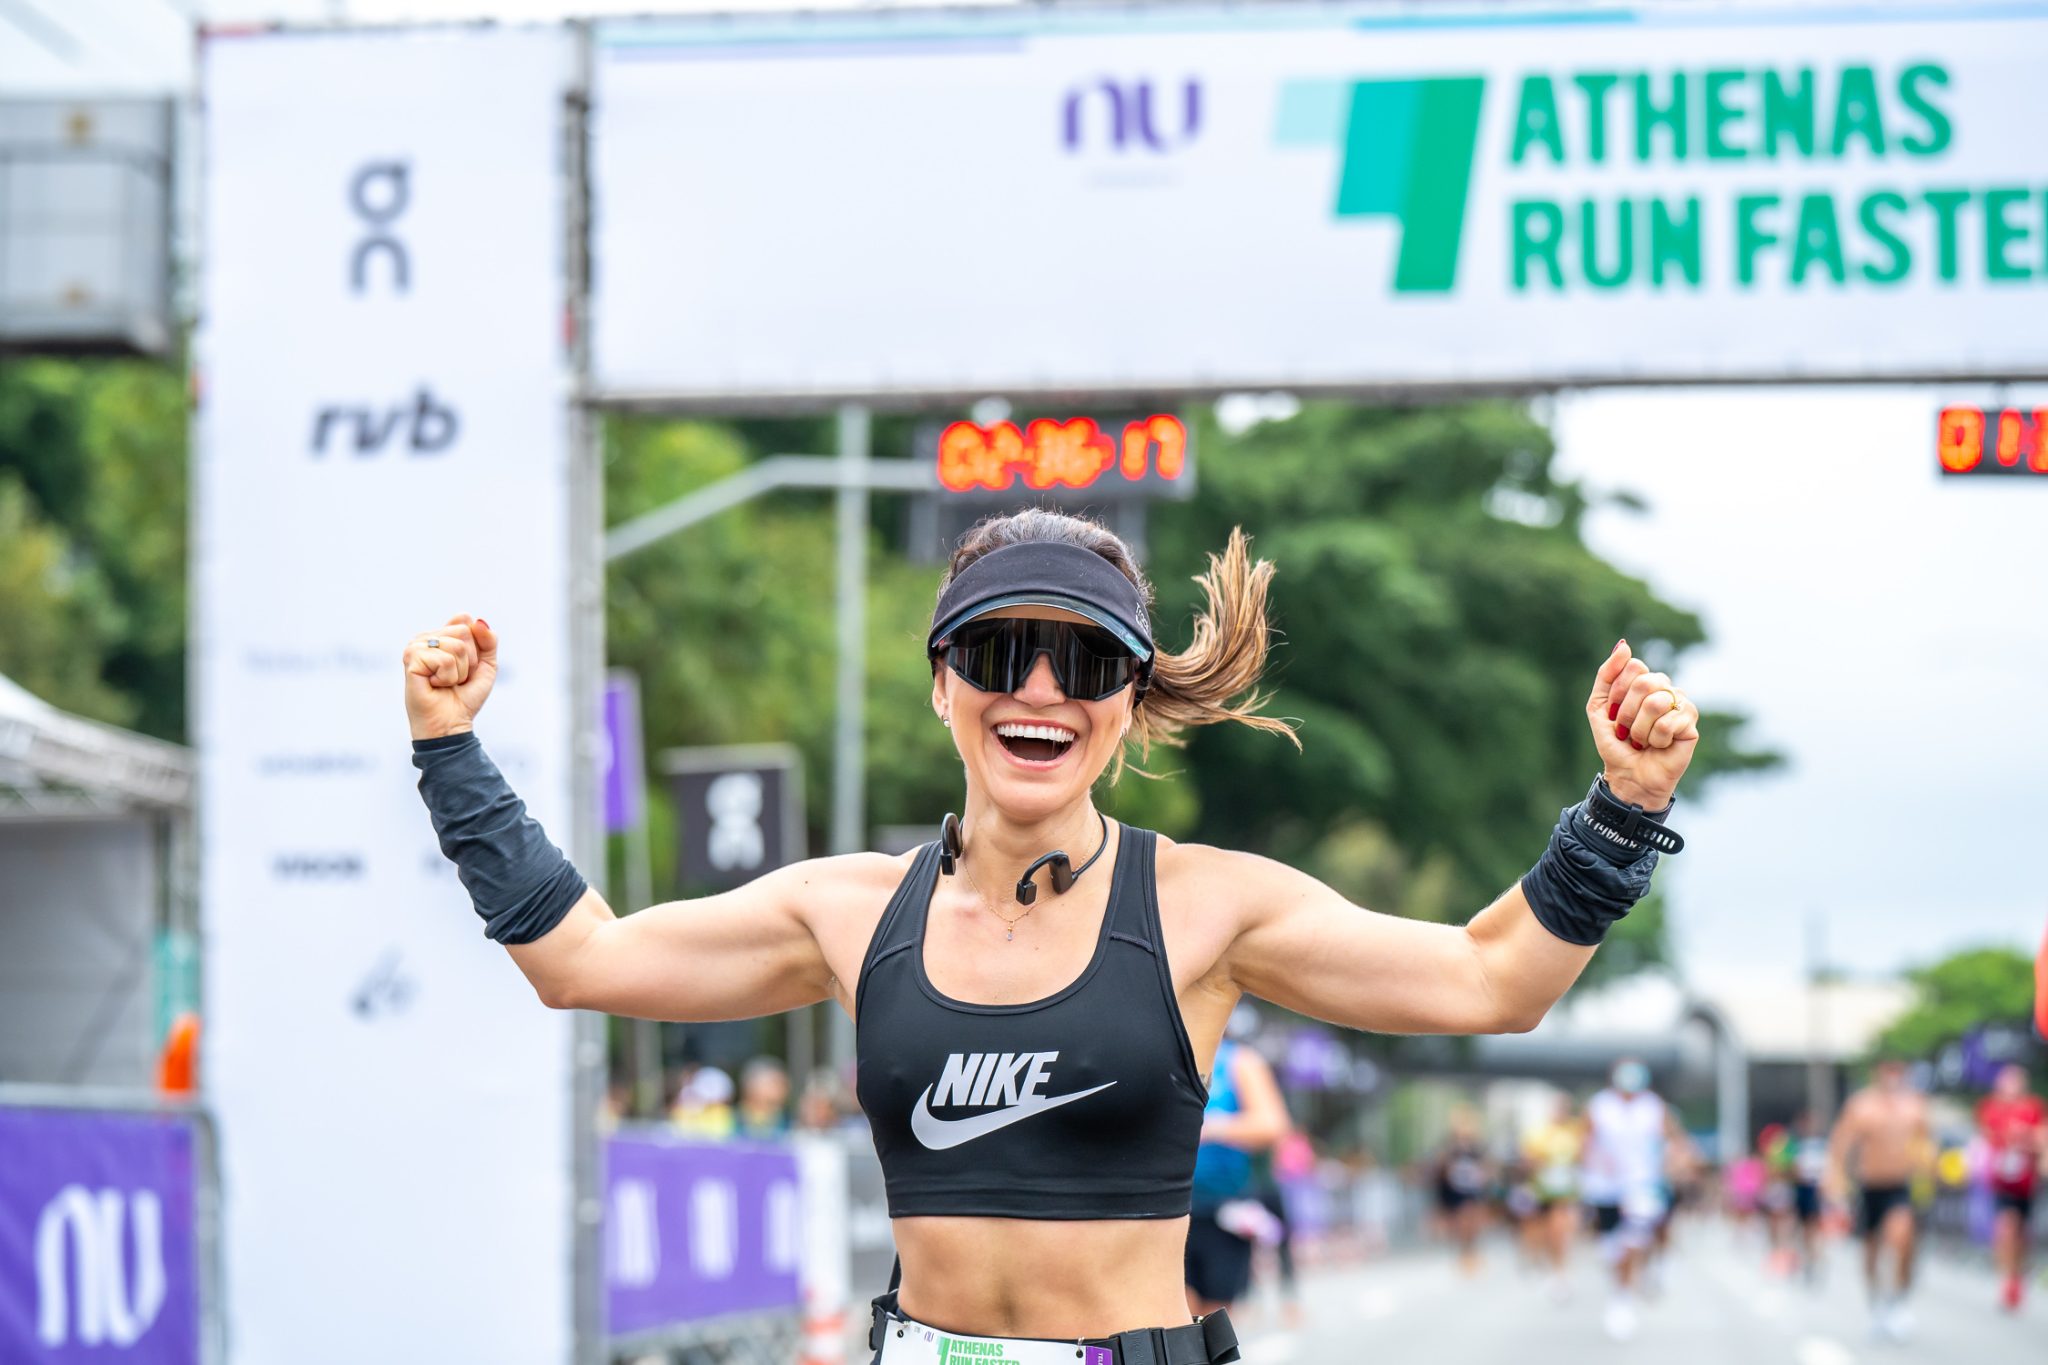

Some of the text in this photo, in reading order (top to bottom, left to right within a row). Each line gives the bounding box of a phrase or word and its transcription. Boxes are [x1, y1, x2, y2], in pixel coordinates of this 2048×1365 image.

[1508, 62, 1954, 165] ATHENAS
[1509, 186, 2048, 291] RUN FASTE
[931, 1051, 1059, 1107] NIKE
[949, 1355, 973, 1365] RUN
[950, 1339, 1004, 1357] ATHENAS
